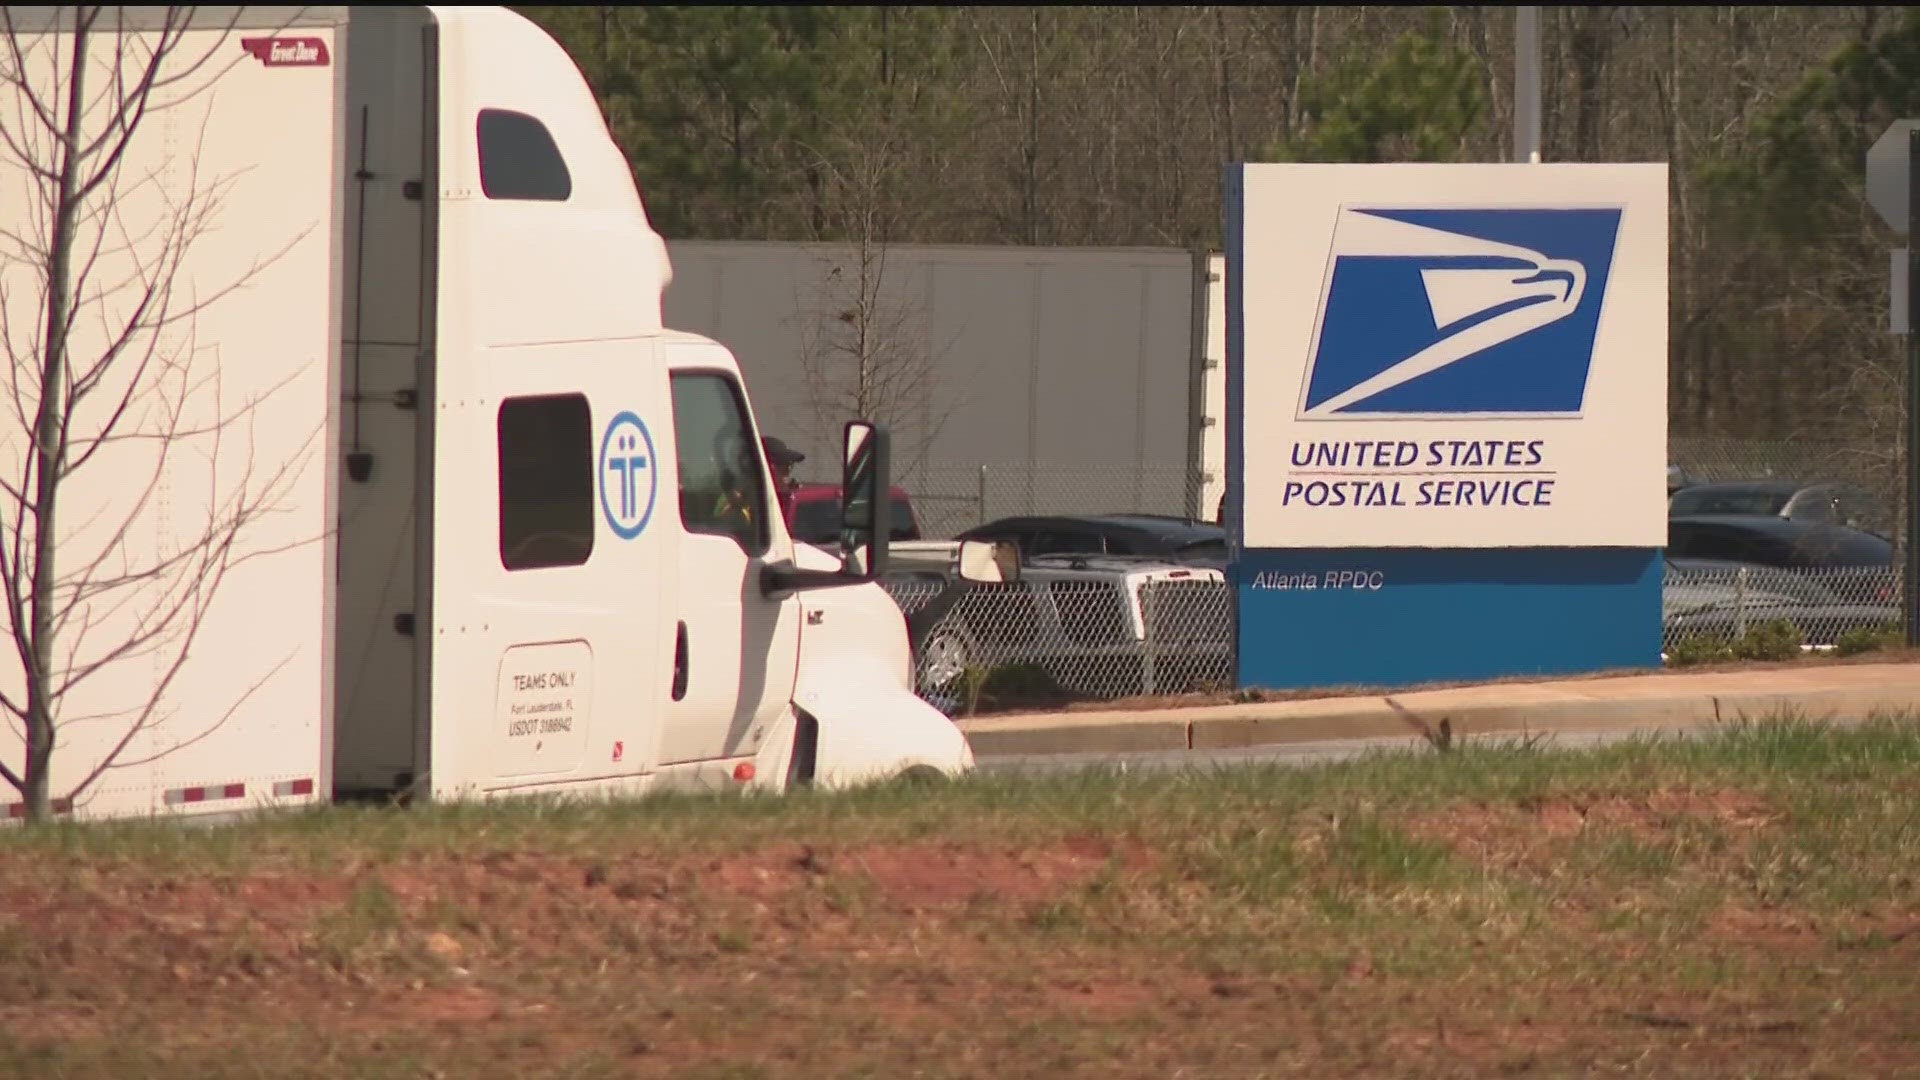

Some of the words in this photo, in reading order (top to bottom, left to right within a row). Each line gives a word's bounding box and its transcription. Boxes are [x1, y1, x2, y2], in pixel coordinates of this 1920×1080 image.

[1290, 440, 1419, 467] UNITED
[1426, 440, 1544, 467] STATES
[1282, 480, 1406, 507] POSTAL
[1415, 480, 1556, 507] SERVICE
[1252, 570, 1318, 590] Atlanta
[1323, 570, 1385, 590] RPDC
[513, 673, 547, 691] TEAMS
[549, 671, 577, 689] ONLY
[508, 719, 539, 737] USDOT
